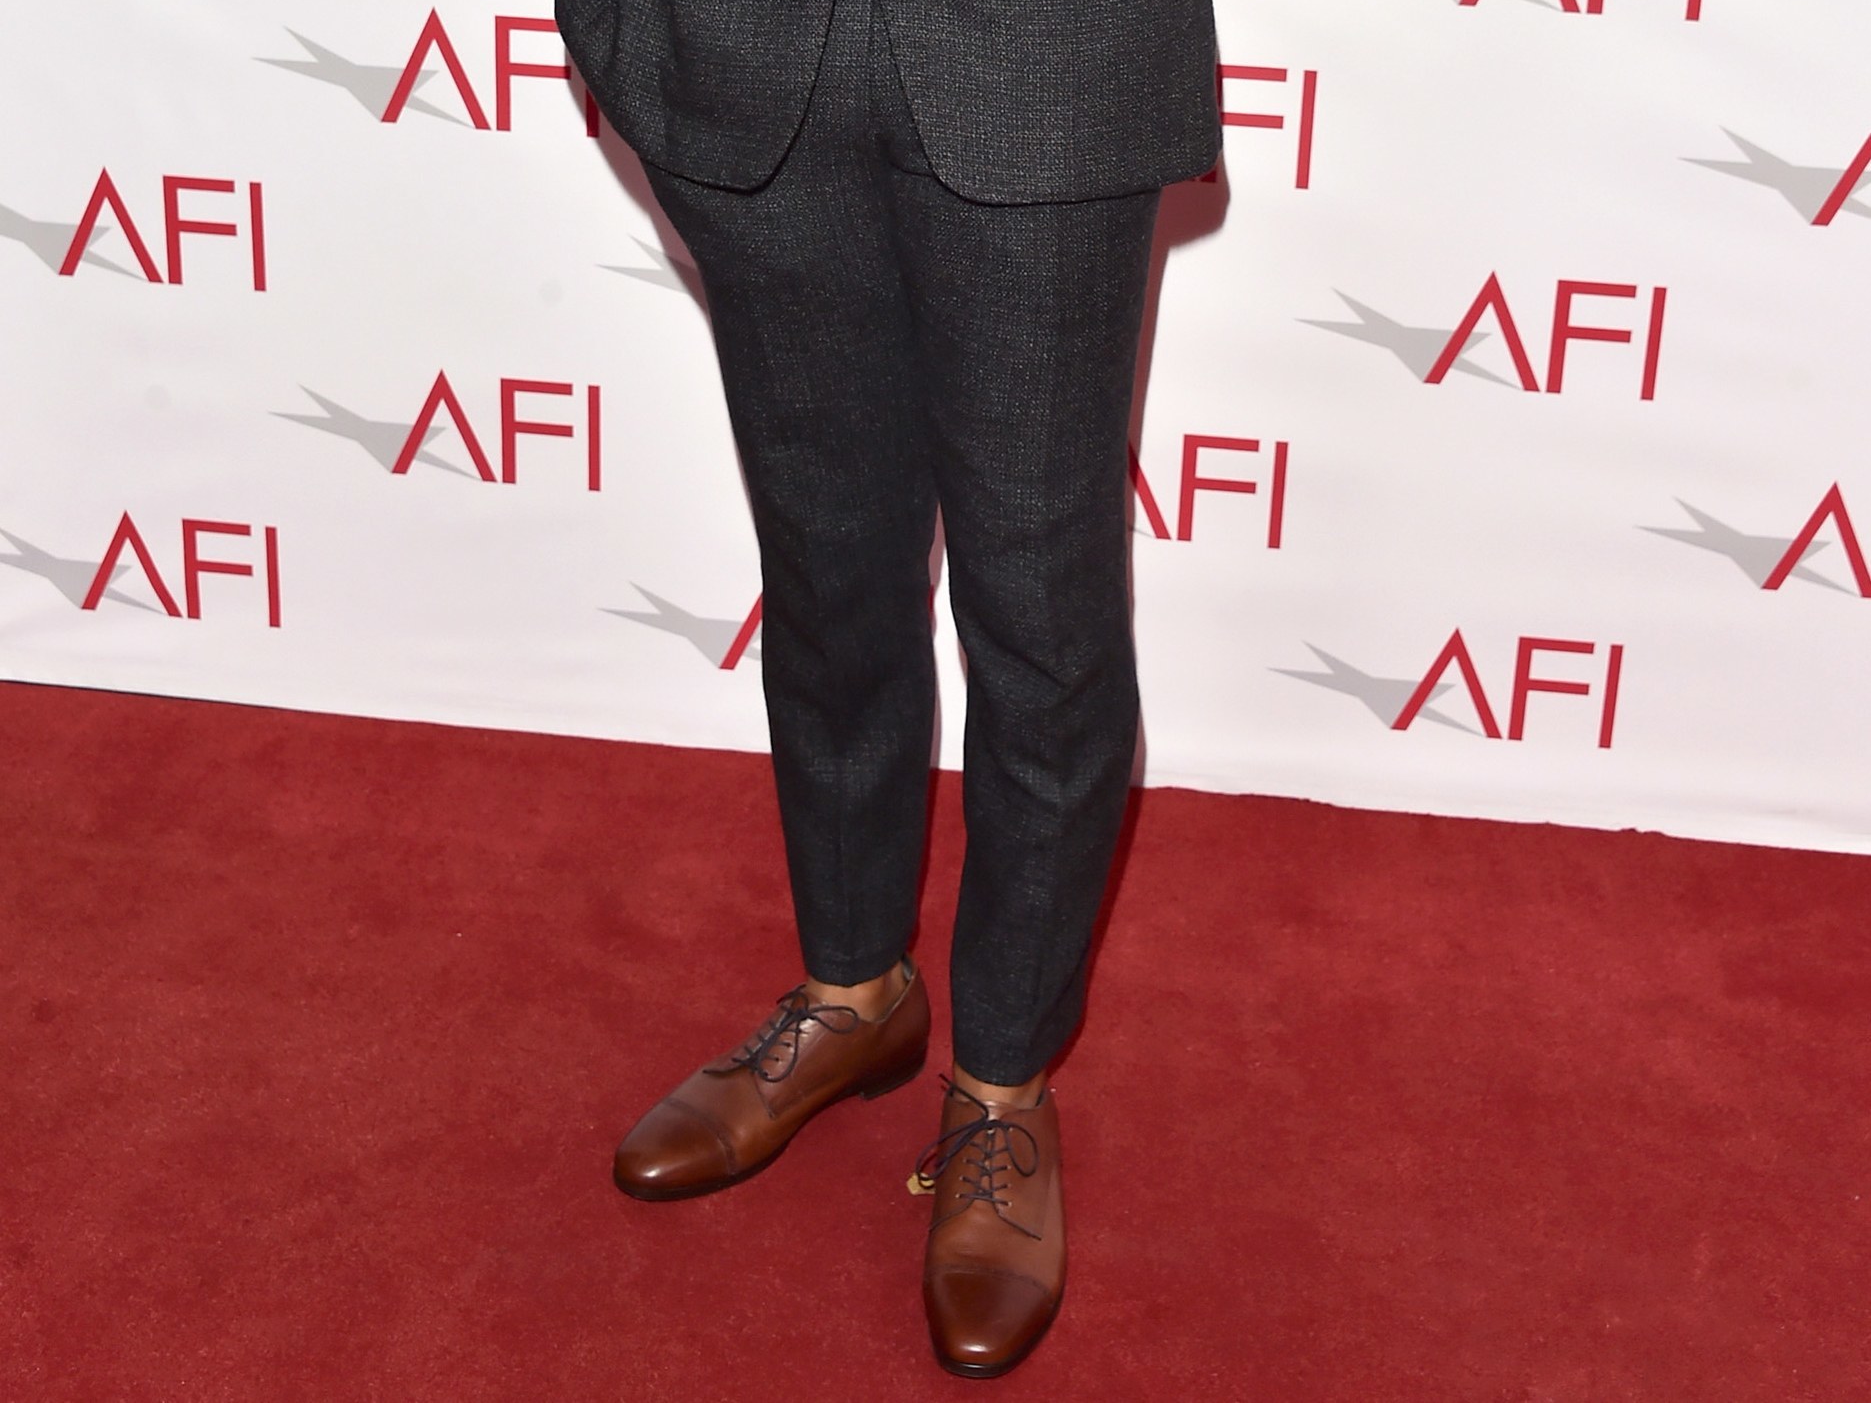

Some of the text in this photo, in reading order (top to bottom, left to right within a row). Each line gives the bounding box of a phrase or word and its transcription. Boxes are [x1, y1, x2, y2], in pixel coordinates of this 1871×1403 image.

[1200, 63, 1319, 191] FI
[57, 166, 268, 293] AFI
[1423, 270, 1669, 402] AFI
[390, 368, 602, 493] AFI
[80, 509, 283, 629] AFI
[1390, 626, 1625, 751] AFI
